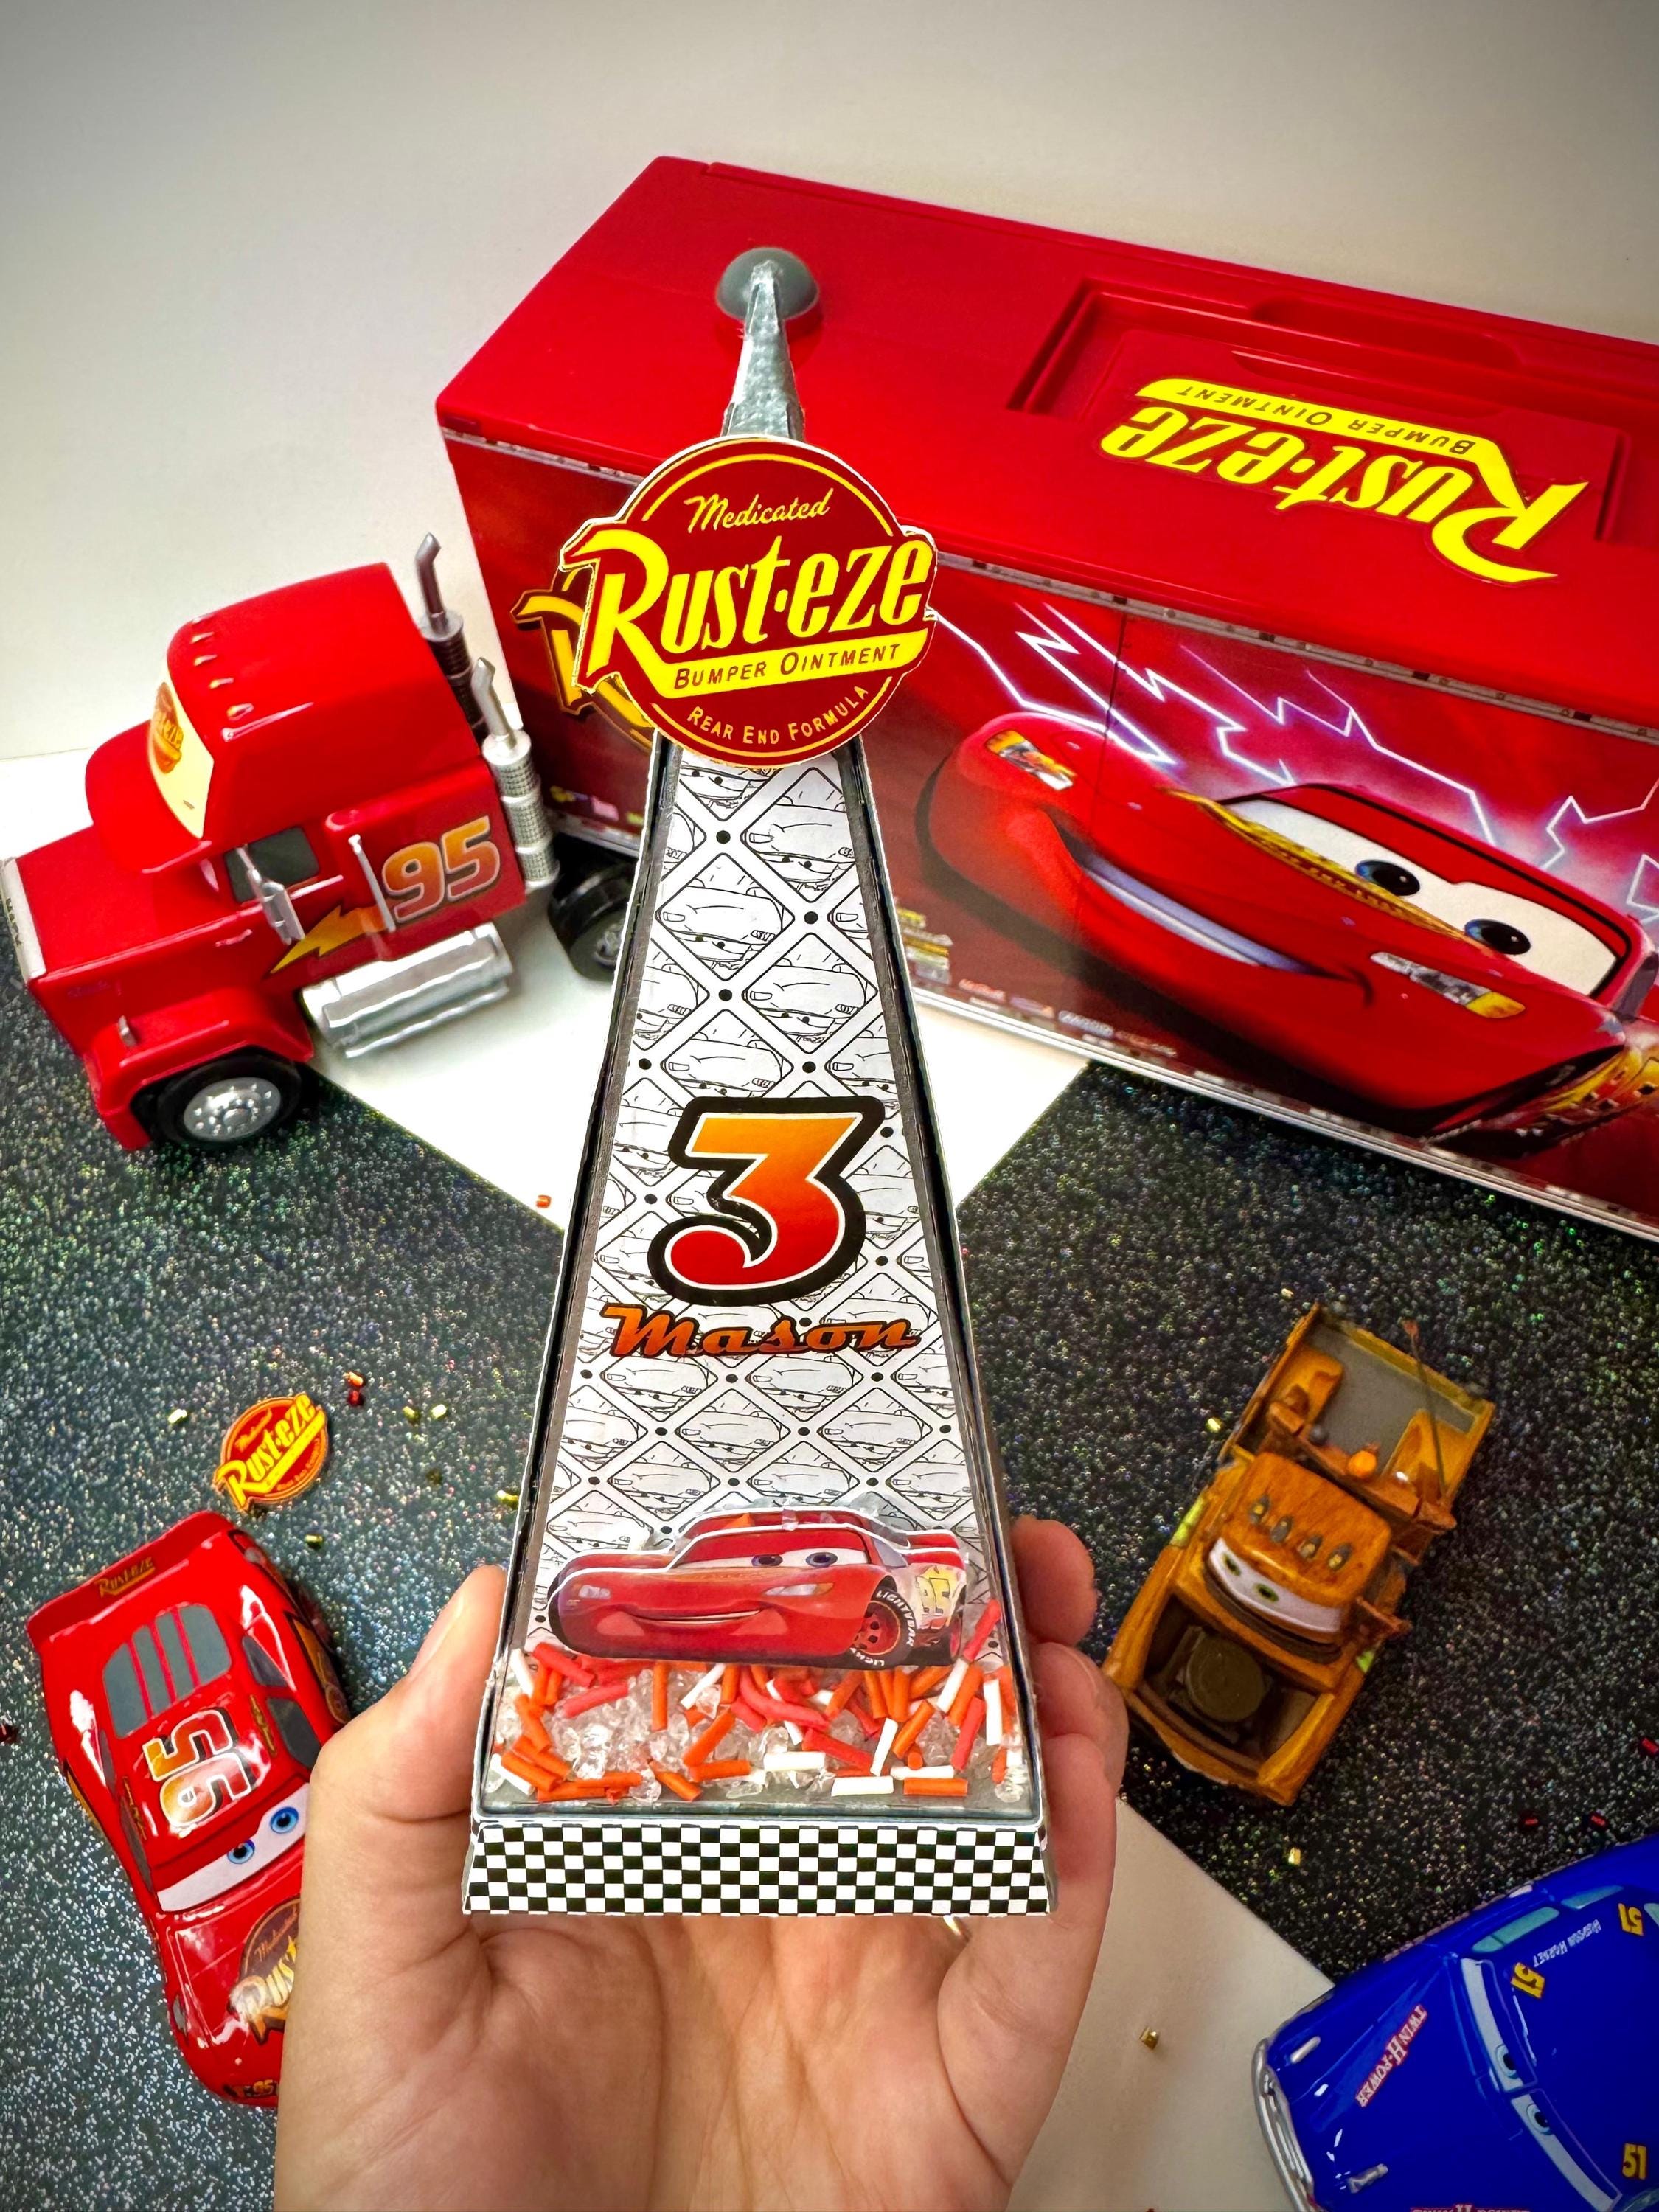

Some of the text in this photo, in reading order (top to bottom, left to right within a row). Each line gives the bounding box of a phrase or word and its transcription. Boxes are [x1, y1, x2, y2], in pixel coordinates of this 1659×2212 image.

[684, 487, 835, 534] Medicated
[686, 683, 869, 745] REAR END FORMULA
[380, 815, 501, 924] 95
[650, 1099, 882, 1304] 3
[599, 1302, 922, 1357] Mason
[143, 1709, 252, 1829] 95
[1618, 1902, 1645, 1936] 51
[1510, 1961, 1545, 1998] 51
[1622, 2143, 1649, 2180] 51
